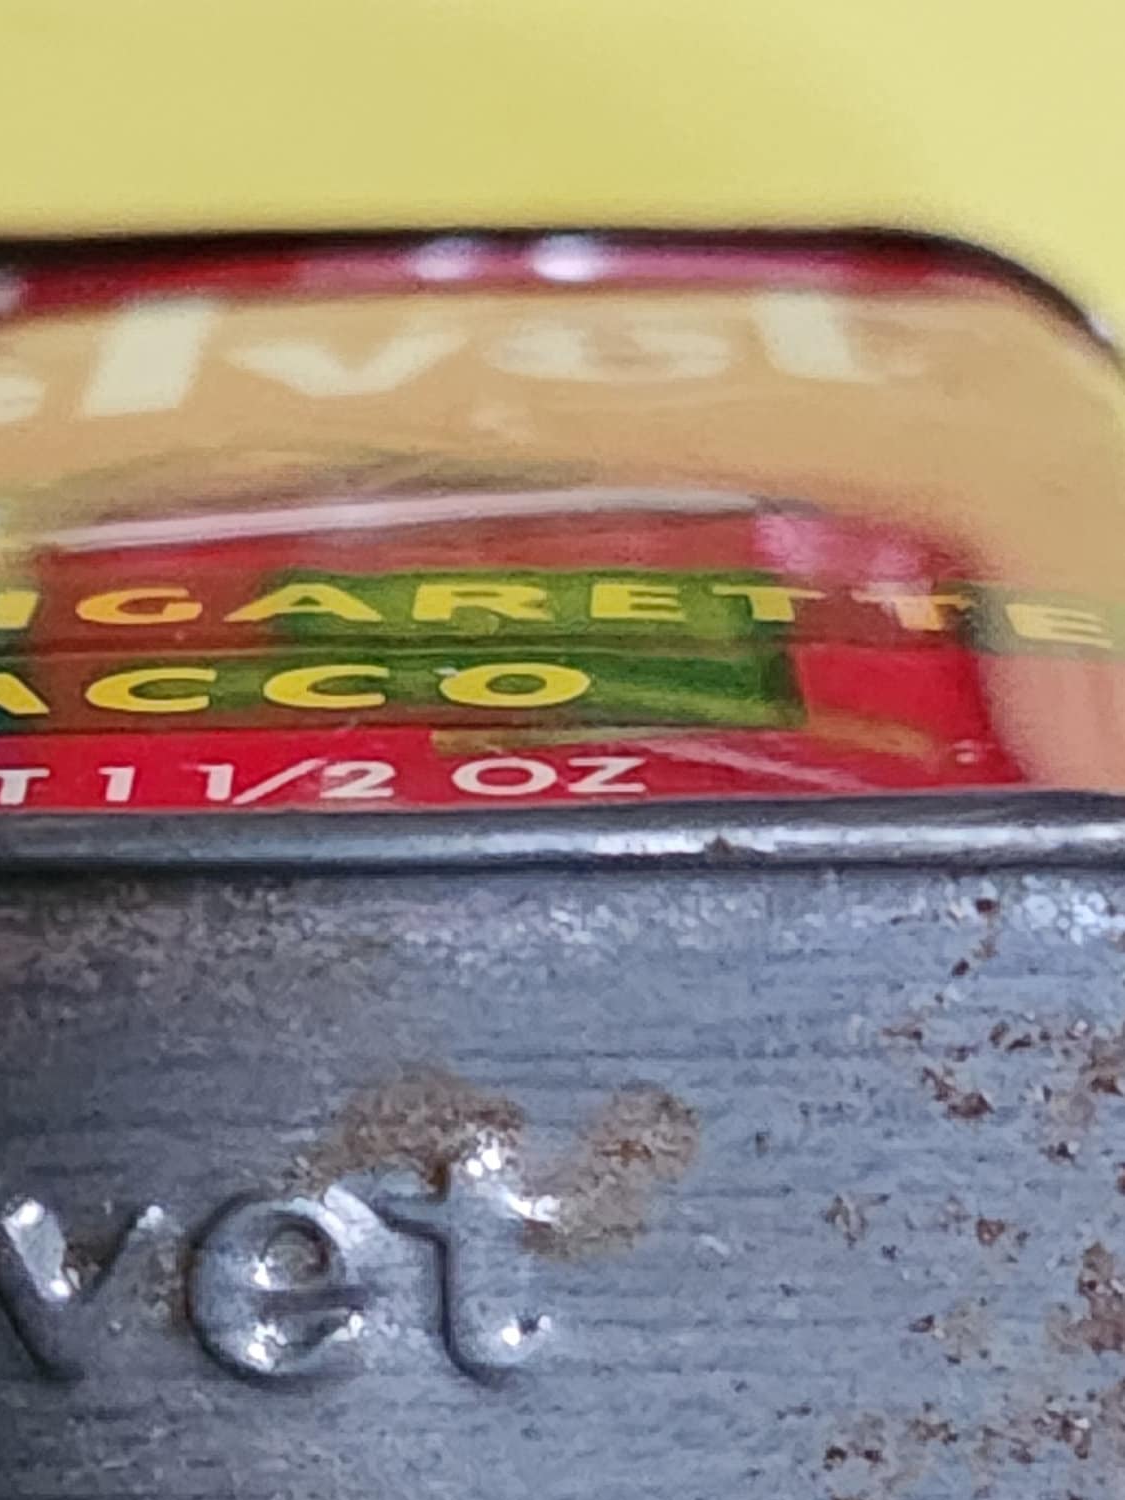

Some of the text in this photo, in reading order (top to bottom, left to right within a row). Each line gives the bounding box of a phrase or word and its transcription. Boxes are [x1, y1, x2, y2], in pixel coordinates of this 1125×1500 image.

[97, 765, 133, 803] 1
[201, 757, 397, 807] 1/2
[451, 755, 649, 799] OZ
